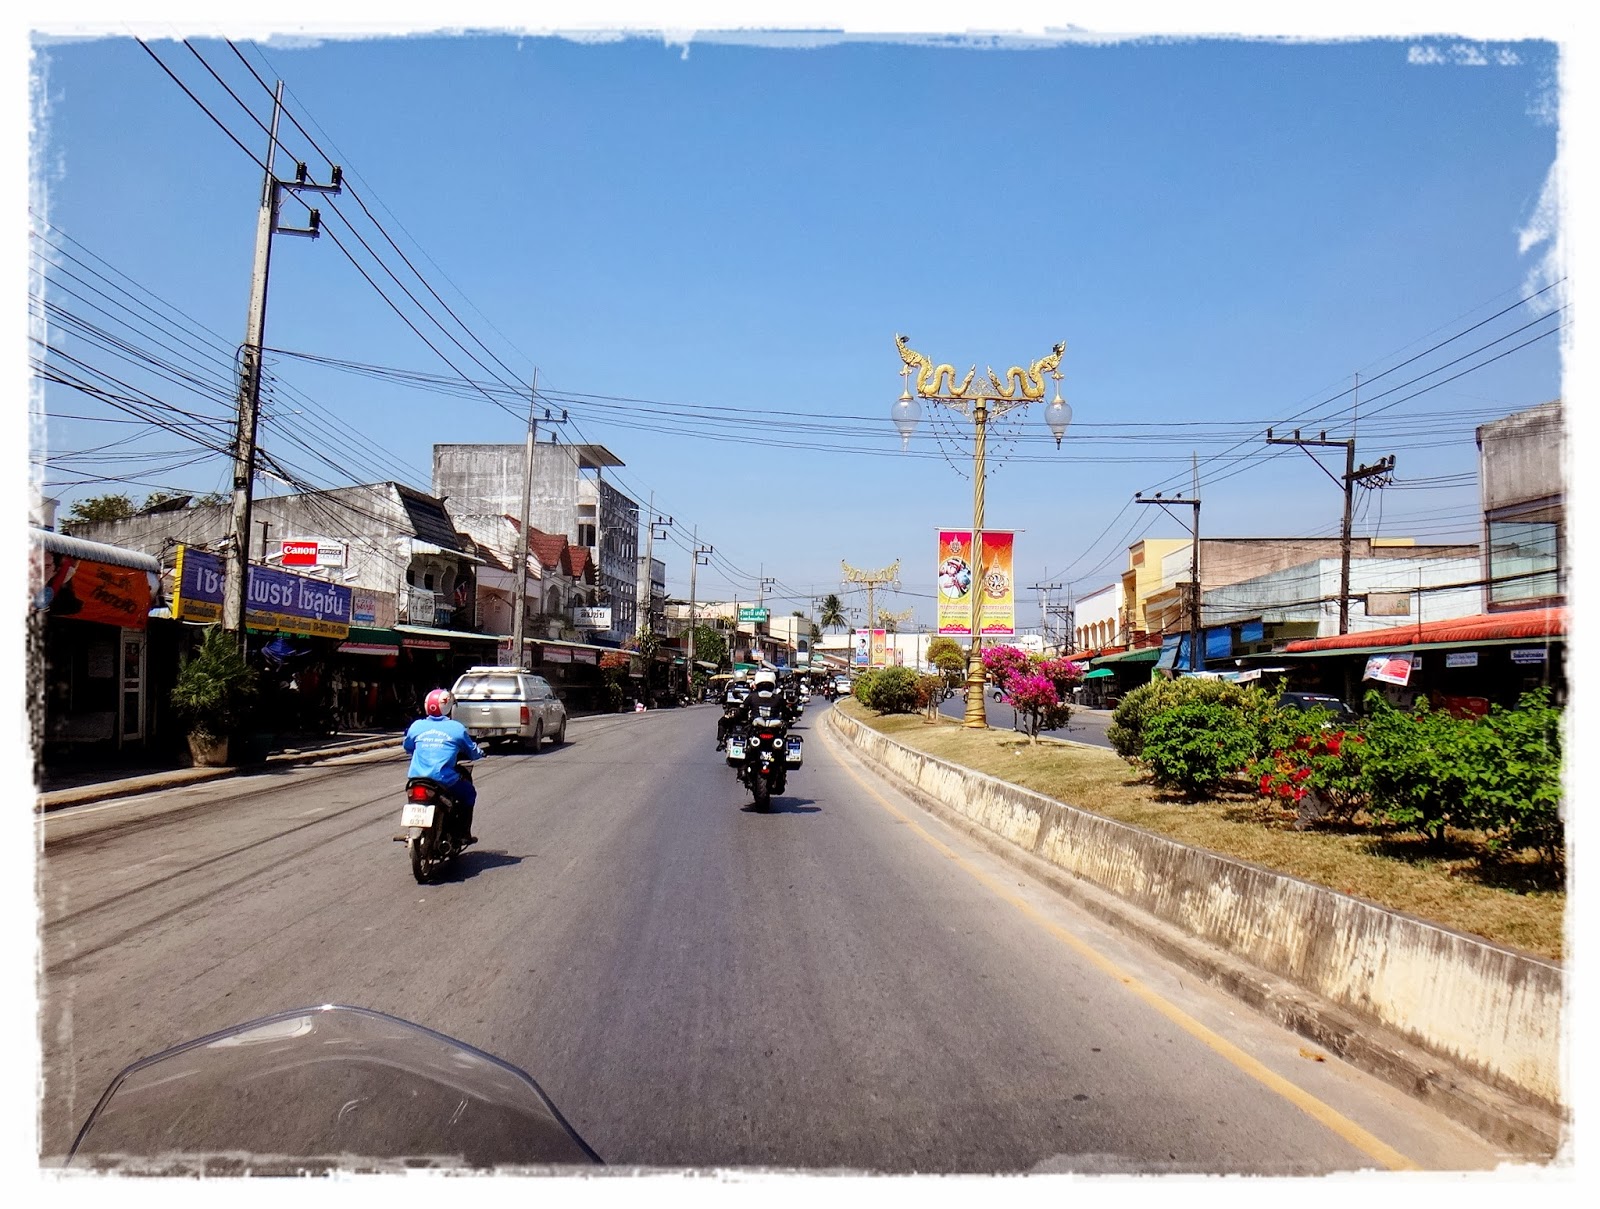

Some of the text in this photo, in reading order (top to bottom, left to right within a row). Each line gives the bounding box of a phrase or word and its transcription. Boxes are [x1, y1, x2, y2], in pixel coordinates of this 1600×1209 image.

[283, 546, 316, 555] Canon
[298, 577, 343, 620] โซลูชั่น
